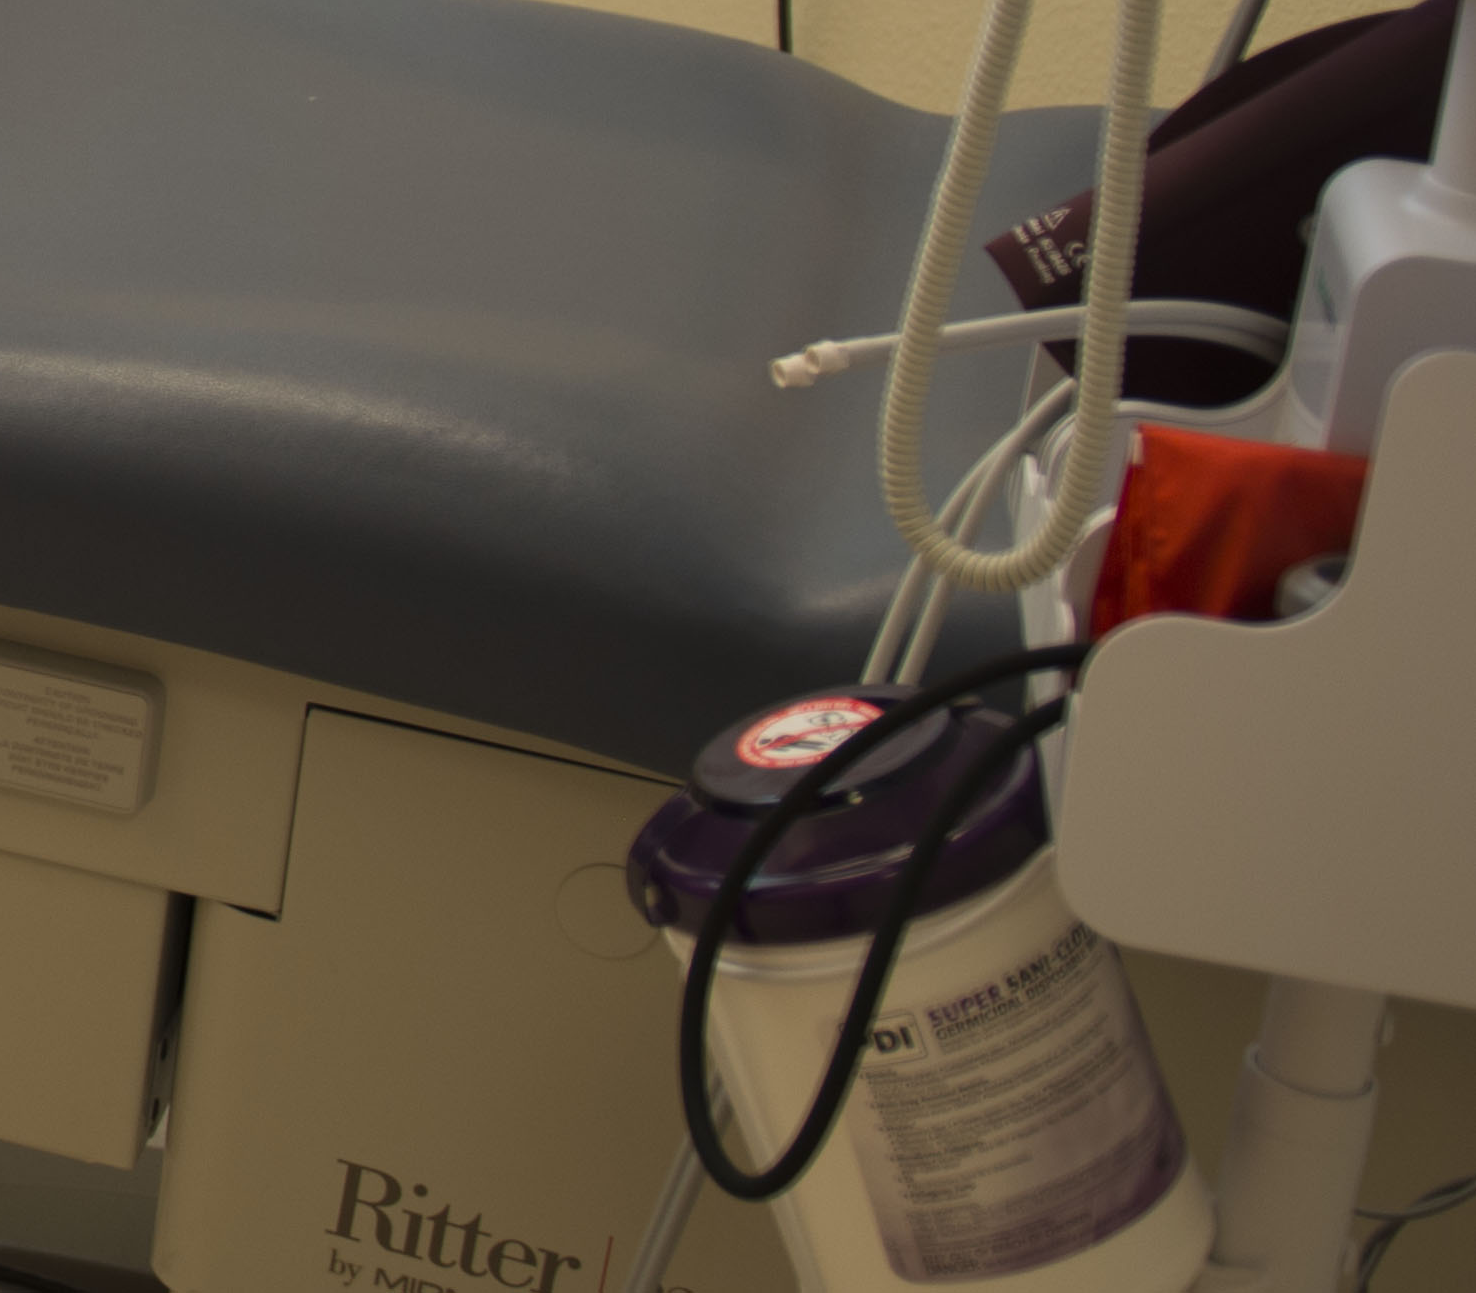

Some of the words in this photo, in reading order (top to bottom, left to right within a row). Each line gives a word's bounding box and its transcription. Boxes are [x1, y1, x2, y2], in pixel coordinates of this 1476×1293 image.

[925, 984, 1002, 1028] SUPER
[934, 998, 1025, 1041] GERMICIDAL
[867, 1025, 916, 1053] DI
[325, 1157, 583, 1293] Ritter
[328, 1249, 363, 1286] by
